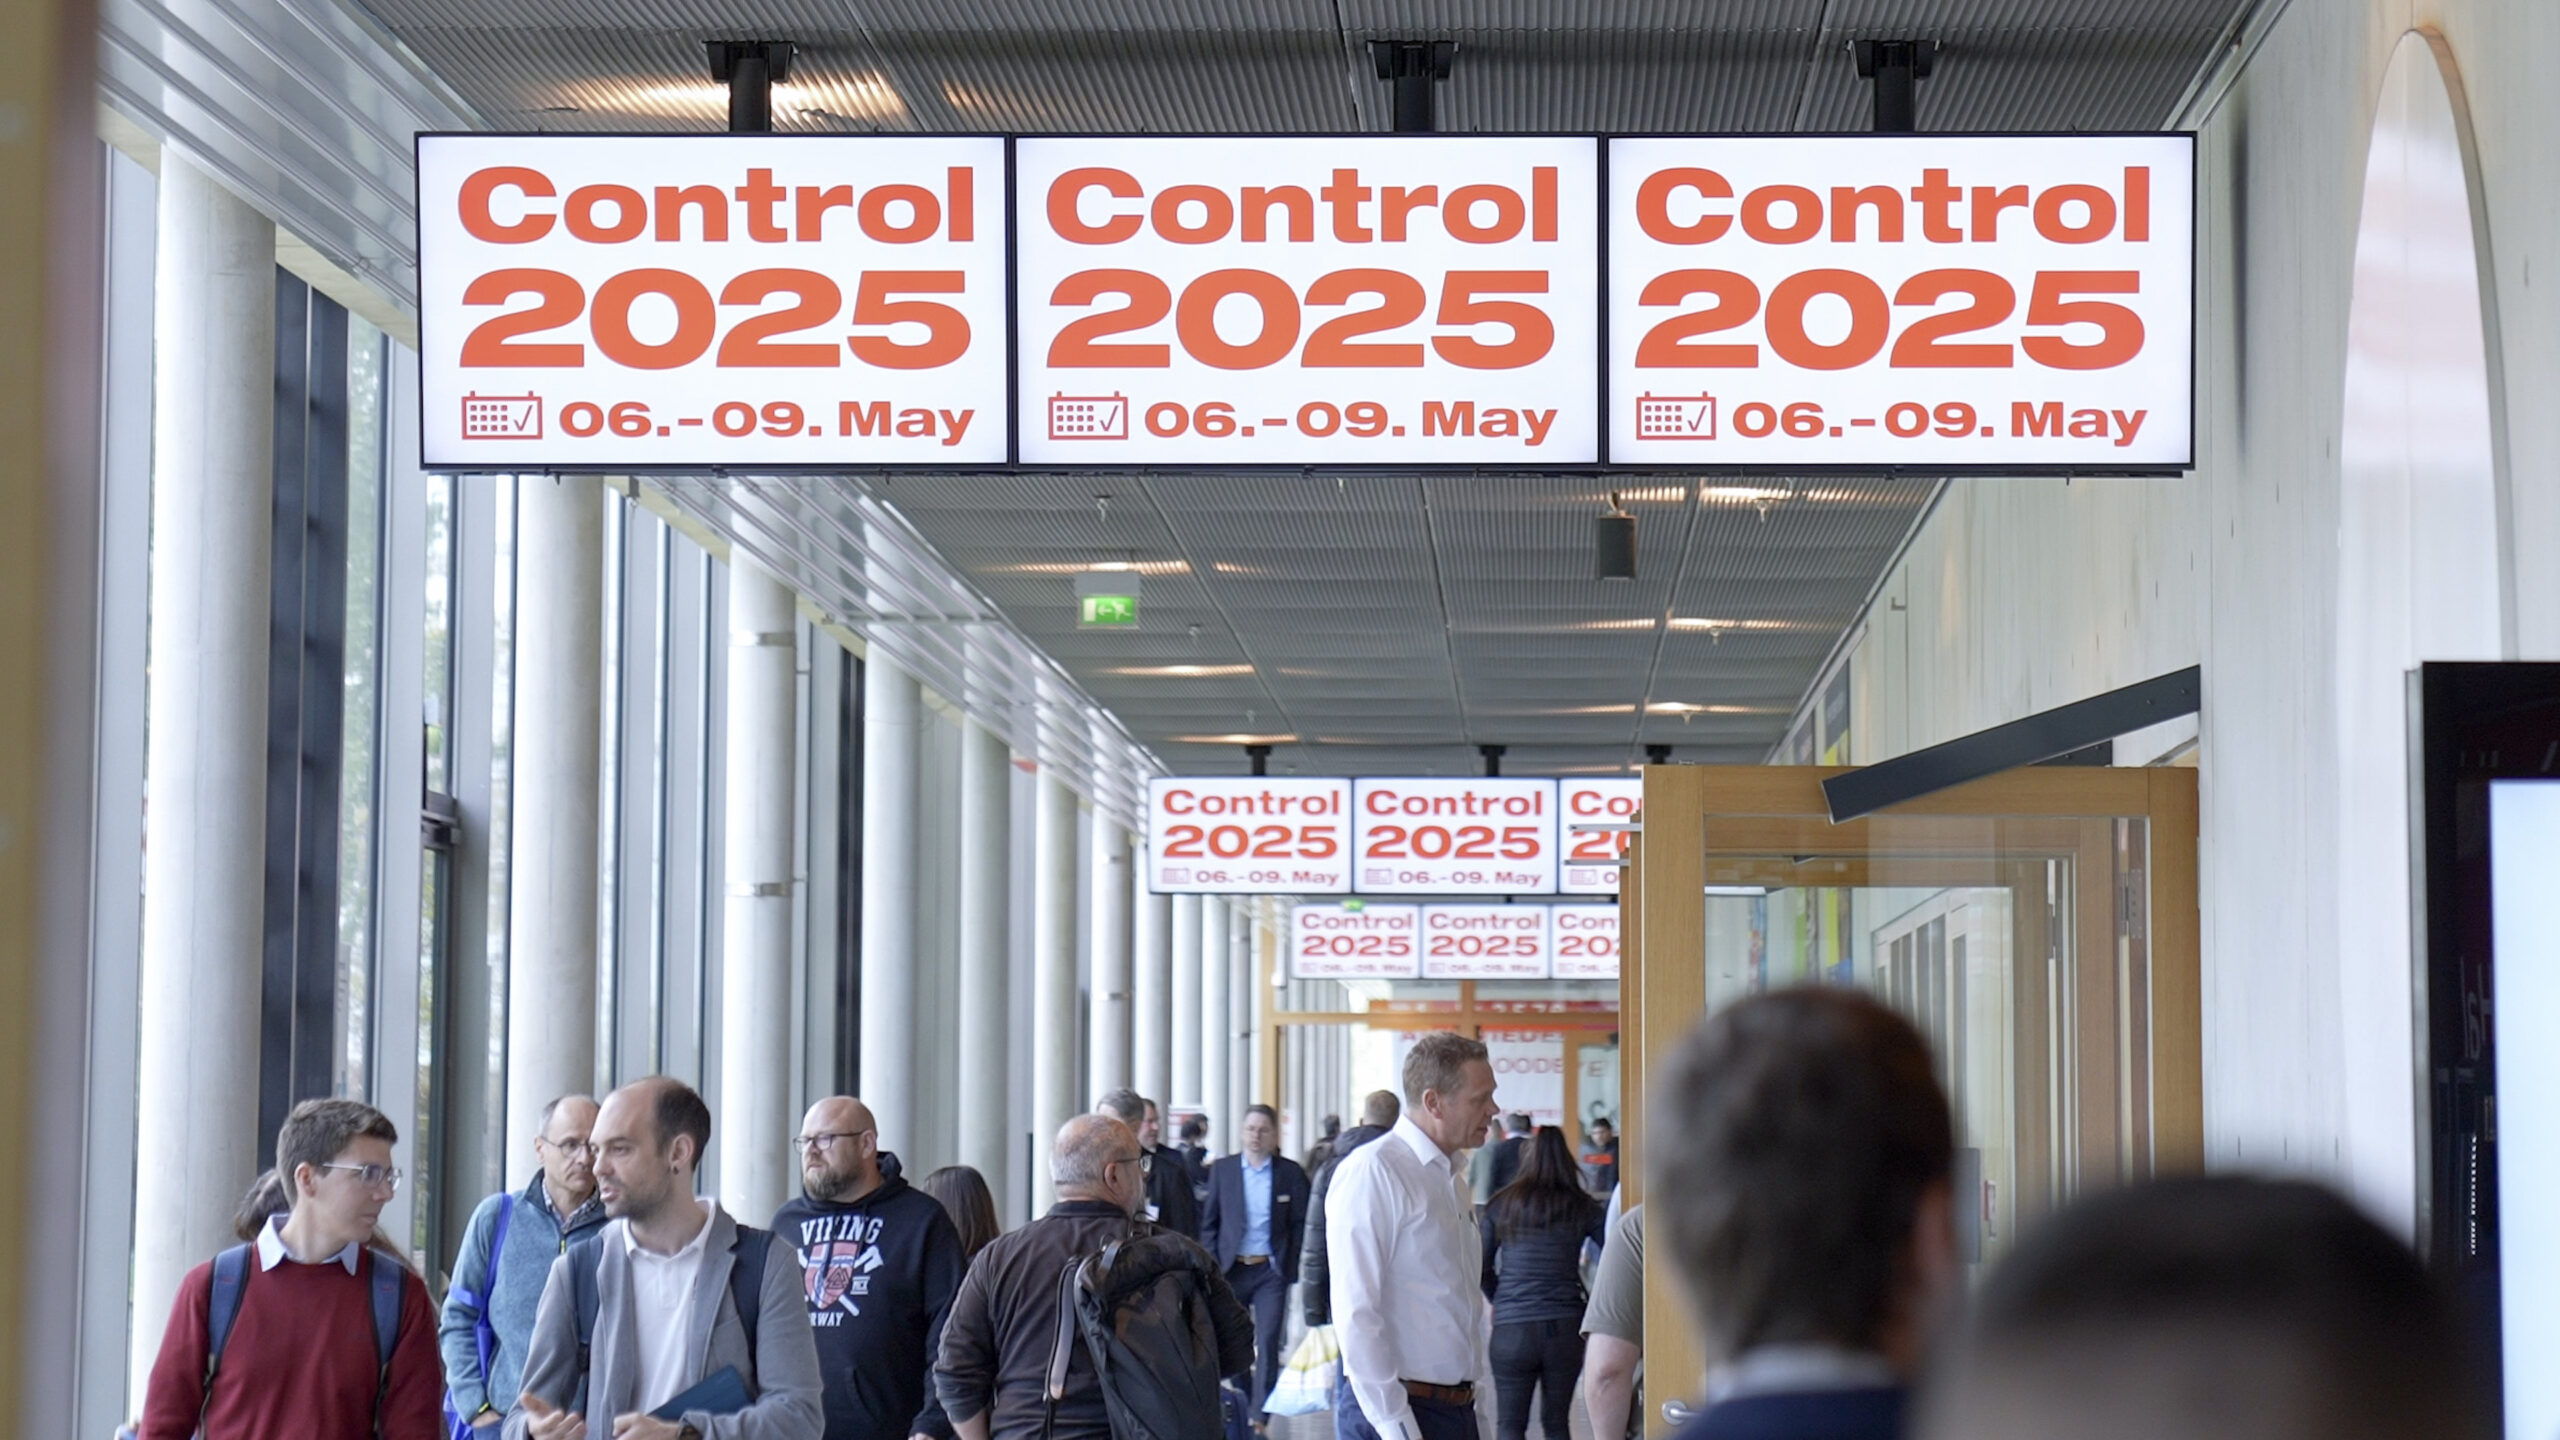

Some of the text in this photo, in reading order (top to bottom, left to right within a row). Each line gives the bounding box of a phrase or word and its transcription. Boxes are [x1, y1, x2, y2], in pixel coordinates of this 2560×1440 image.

[458, 166, 974, 244] Control
[1047, 166, 1558, 244] Control
[1636, 166, 2150, 245] Control
[459, 267, 971, 370] 2025
[1047, 267, 1555, 370] 2025
[1635, 267, 2145, 371] 2025
[839, 401, 975, 446] May
[1423, 401, 1557, 446] May
[2011, 401, 2147, 447] May
[1163, 789, 1340, 816] Control
[1366, 790, 1543, 817] Control
[1571, 790, 1642, 816] Co
[1163, 824, 1339, 859] 2025
[1366, 825, 1541, 860] 2025
[1291, 870, 1340, 887] May
[1493, 870, 1543, 887] May
[1301, 912, 1414, 930] Control
[1429, 912, 1541, 930] Control
[1559, 913, 1619, 930] Con
[1302, 935, 1411, 957] 2025
[1430, 935, 1539, 957] 2025
[1559, 935, 1621, 957] 20
[808, 1311, 845, 1327] RWAY
